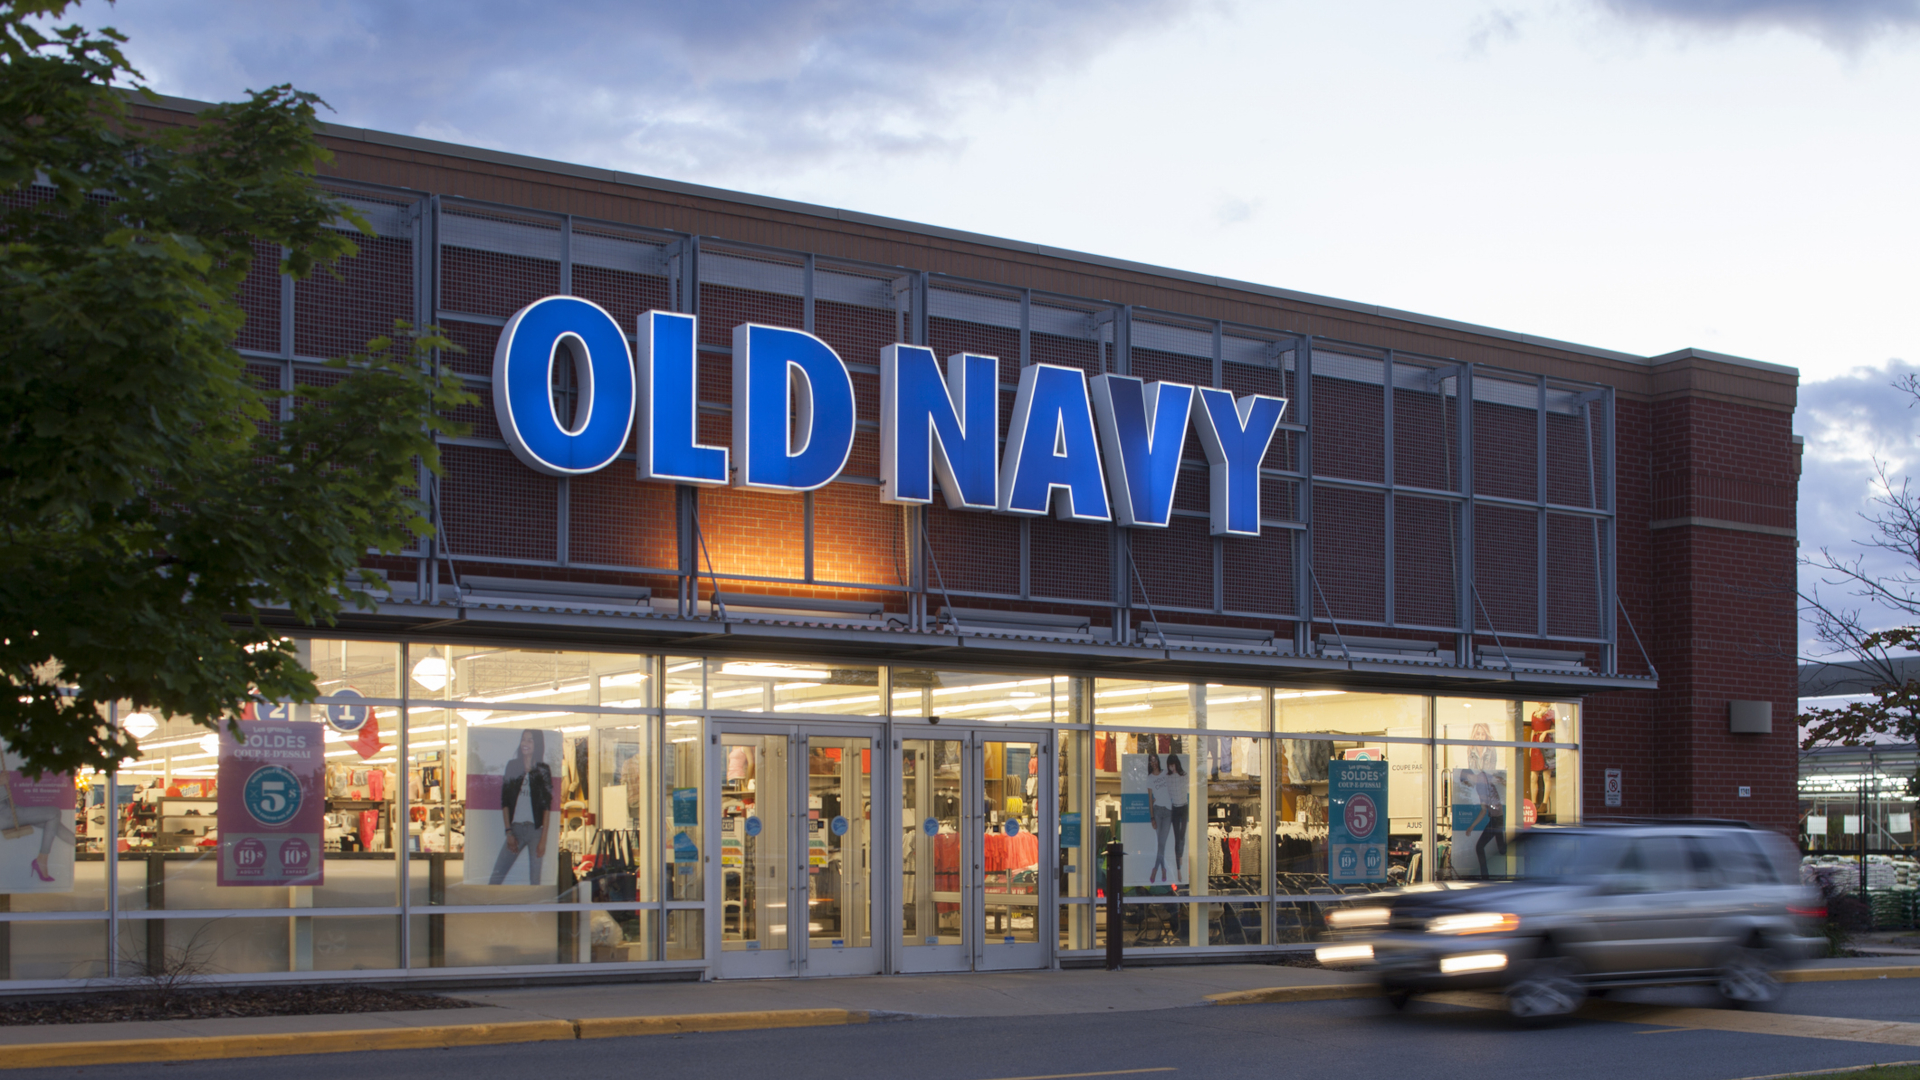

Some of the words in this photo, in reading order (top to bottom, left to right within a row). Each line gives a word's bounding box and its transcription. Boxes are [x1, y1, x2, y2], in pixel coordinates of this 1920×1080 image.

[493, 295, 856, 493] OLD
[880, 342, 1289, 538] NAVY
[1341, 771, 1379, 781] SOLDES
